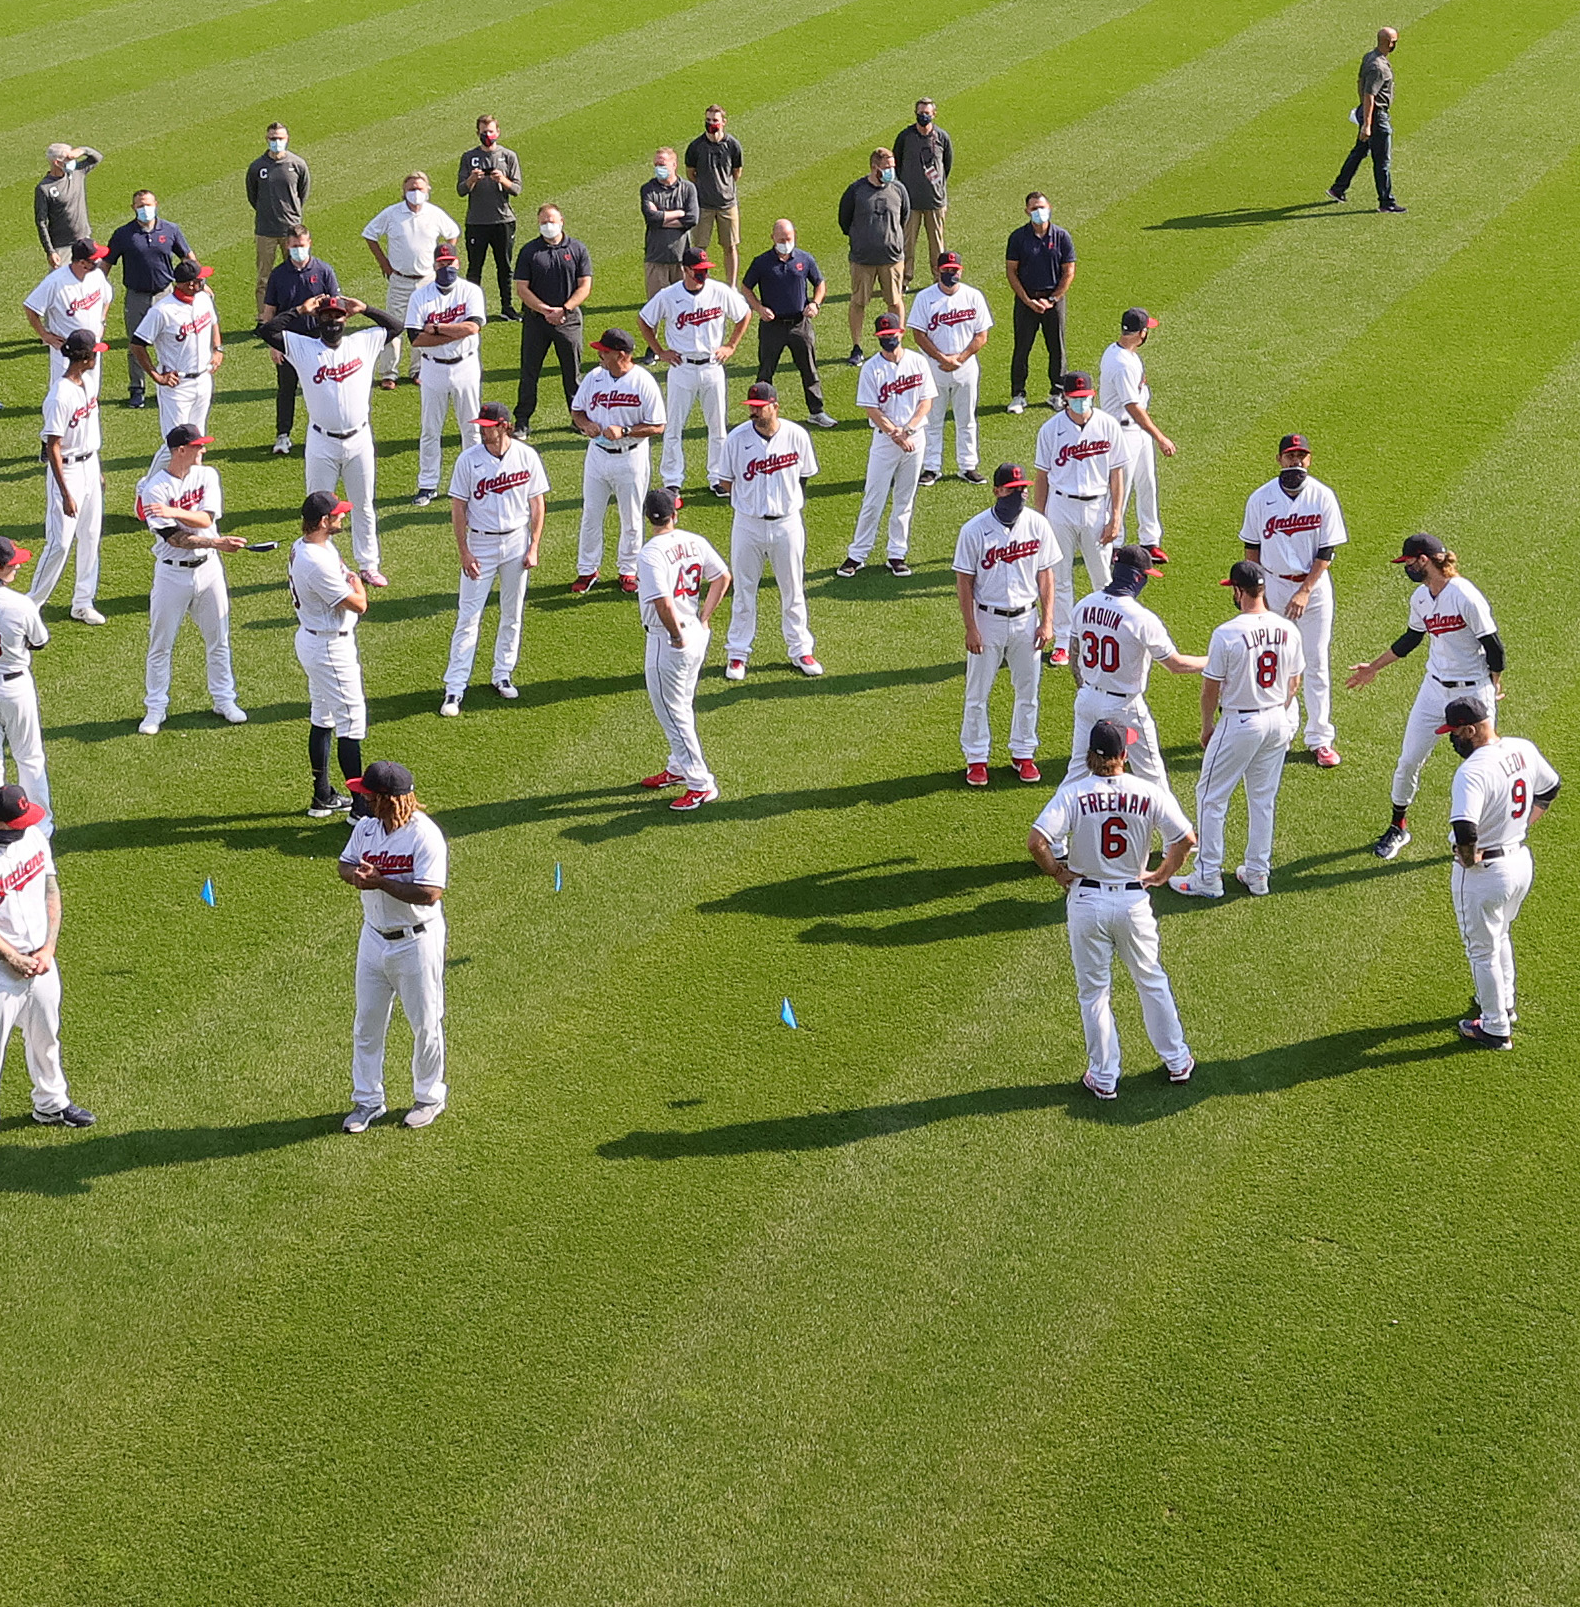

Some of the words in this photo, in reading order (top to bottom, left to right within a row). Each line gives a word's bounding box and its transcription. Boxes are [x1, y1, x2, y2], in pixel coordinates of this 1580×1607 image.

[259, 167, 269, 180] C
[66, 289, 102, 317] Indians
[175, 311, 212, 342] Indians
[675, 306, 723, 330] Indians
[927, 308, 977, 332] Indians
[312, 357, 363, 384] Indians
[589, 390, 642, 410] Indians
[878, 373, 923, 404] Indians
[743, 450, 799, 482] Indians
[1055, 440, 1111, 467] Indians
[473, 469, 531, 500] Indians
[1263, 513, 1322, 540] Indians
[981, 538, 1041, 571] Indians
[674, 562, 702, 598] 43
[1082, 606, 1123, 632] NAQUIN
[1081, 631, 1120, 673] 30
[1256, 650, 1278, 689] 8
[1498, 751, 1527, 779] LEON
[1077, 792, 1150, 818] FREEMAN
[1510, 777, 1527, 820] 9
[1101, 817, 1128, 860] 6
[359, 850, 416, 875] Indians
